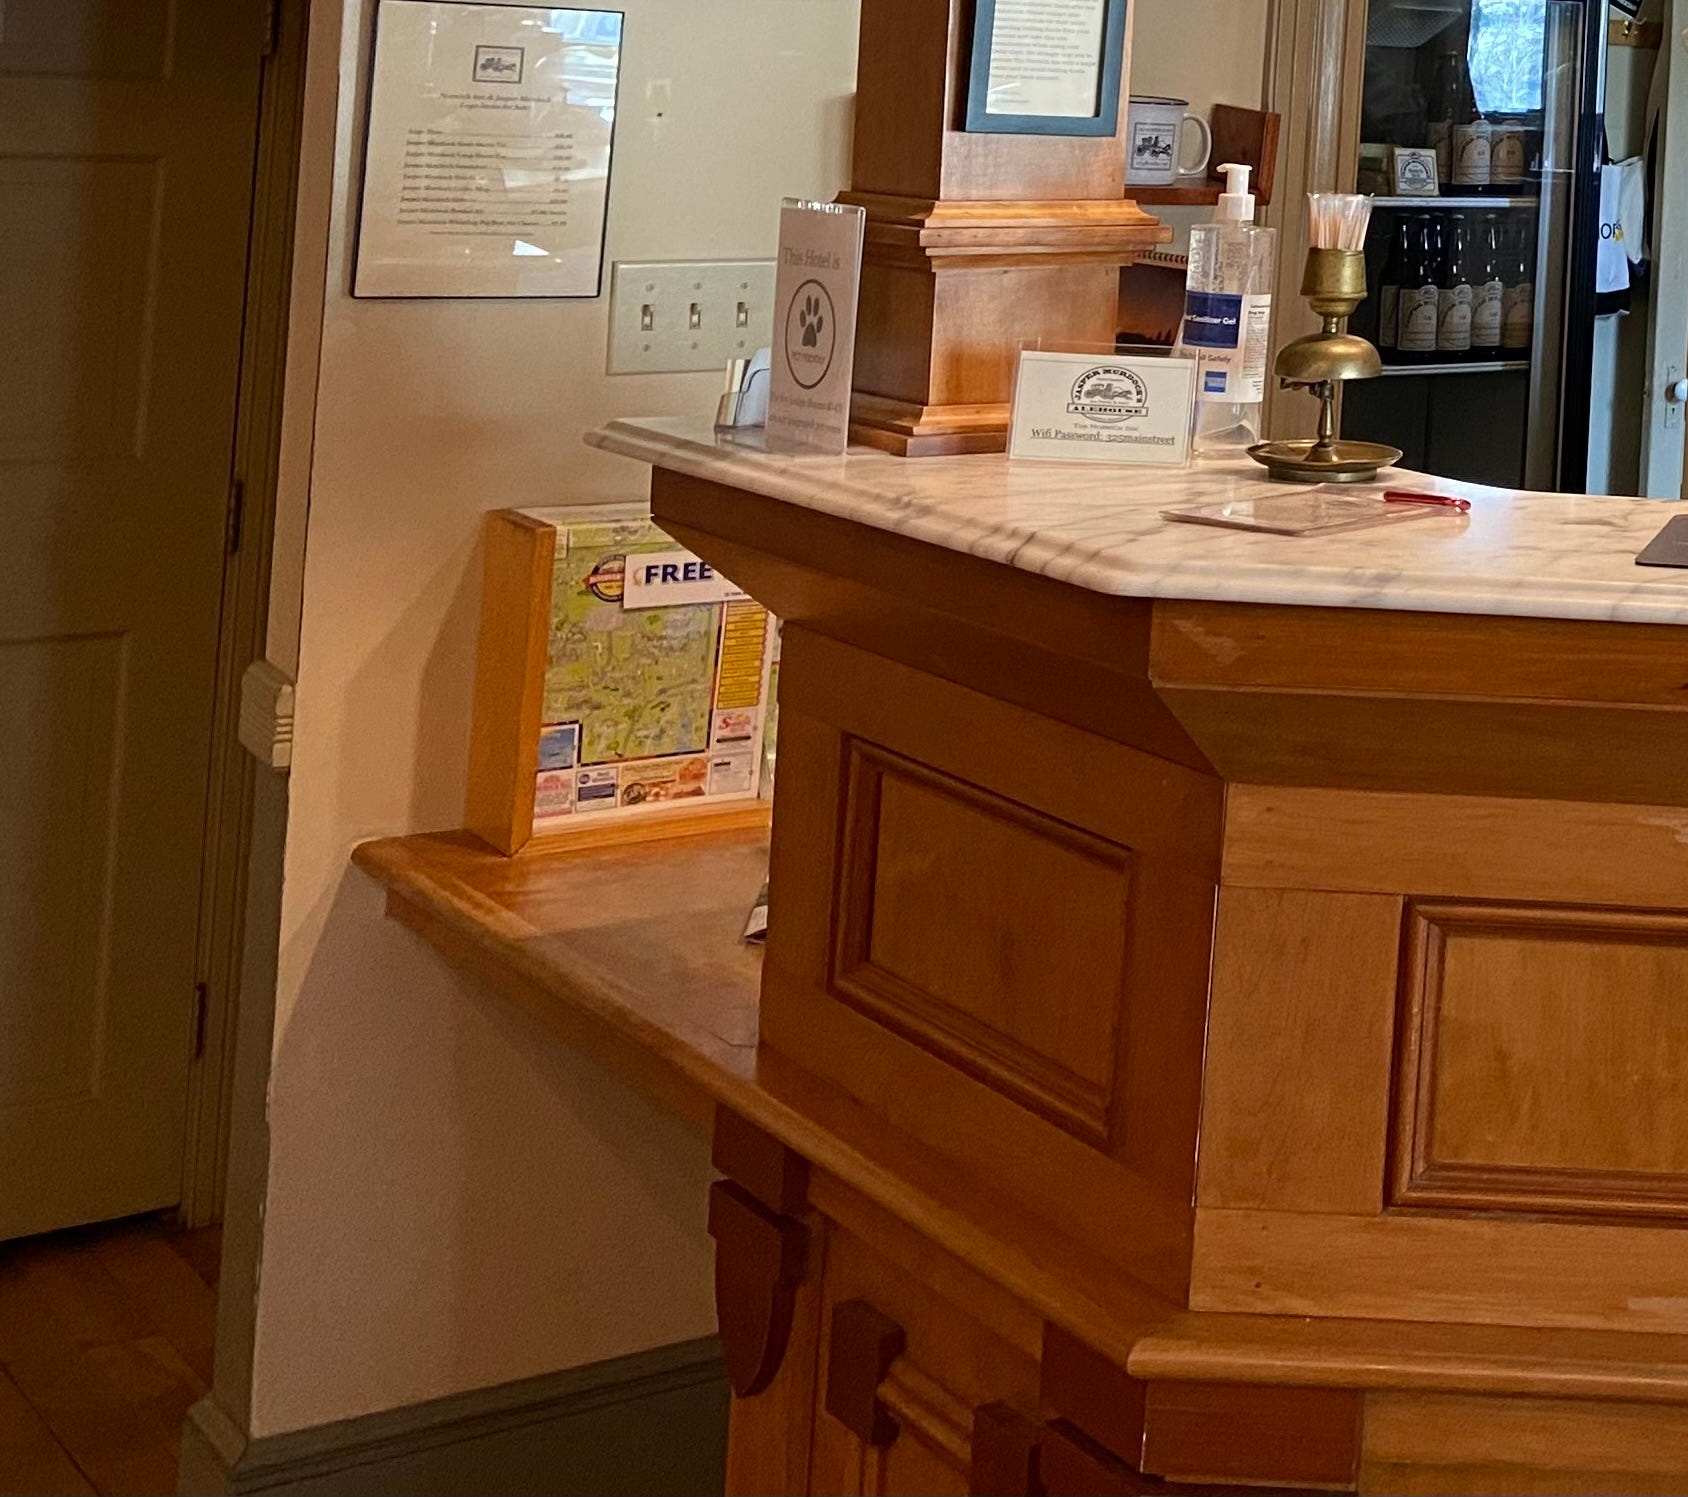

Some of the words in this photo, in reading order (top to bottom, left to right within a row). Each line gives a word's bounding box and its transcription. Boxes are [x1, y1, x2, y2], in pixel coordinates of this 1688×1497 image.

[783, 247, 803, 266] This
[1031, 428, 1051, 438] Wifi
[644, 562, 713, 585] FREE
